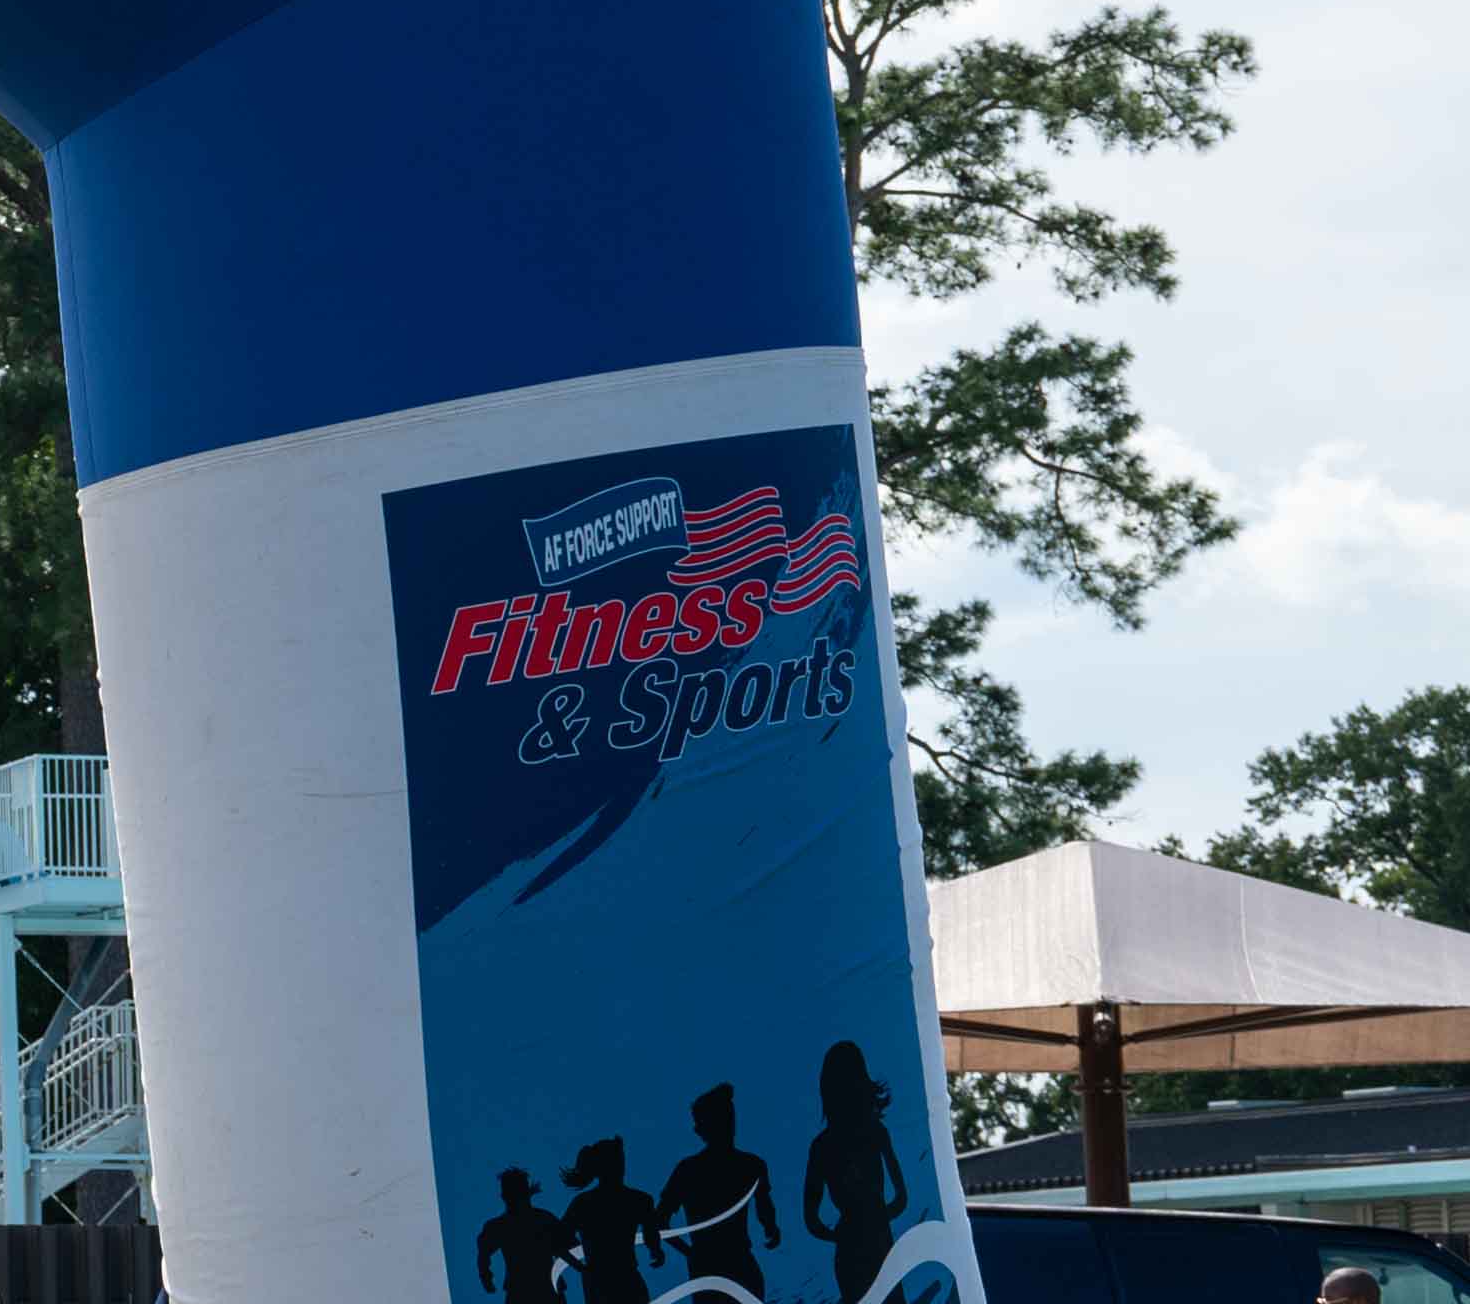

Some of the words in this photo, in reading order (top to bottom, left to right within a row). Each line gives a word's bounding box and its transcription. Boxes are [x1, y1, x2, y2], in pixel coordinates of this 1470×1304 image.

[544, 534, 563, 573] AF
[565, 513, 615, 568] FORCE
[615, 491, 678, 547] SUPPORT
[431, 578, 768, 696] Fitness
[518, 683, 591, 765] &
[607, 636, 856, 762] Sports
